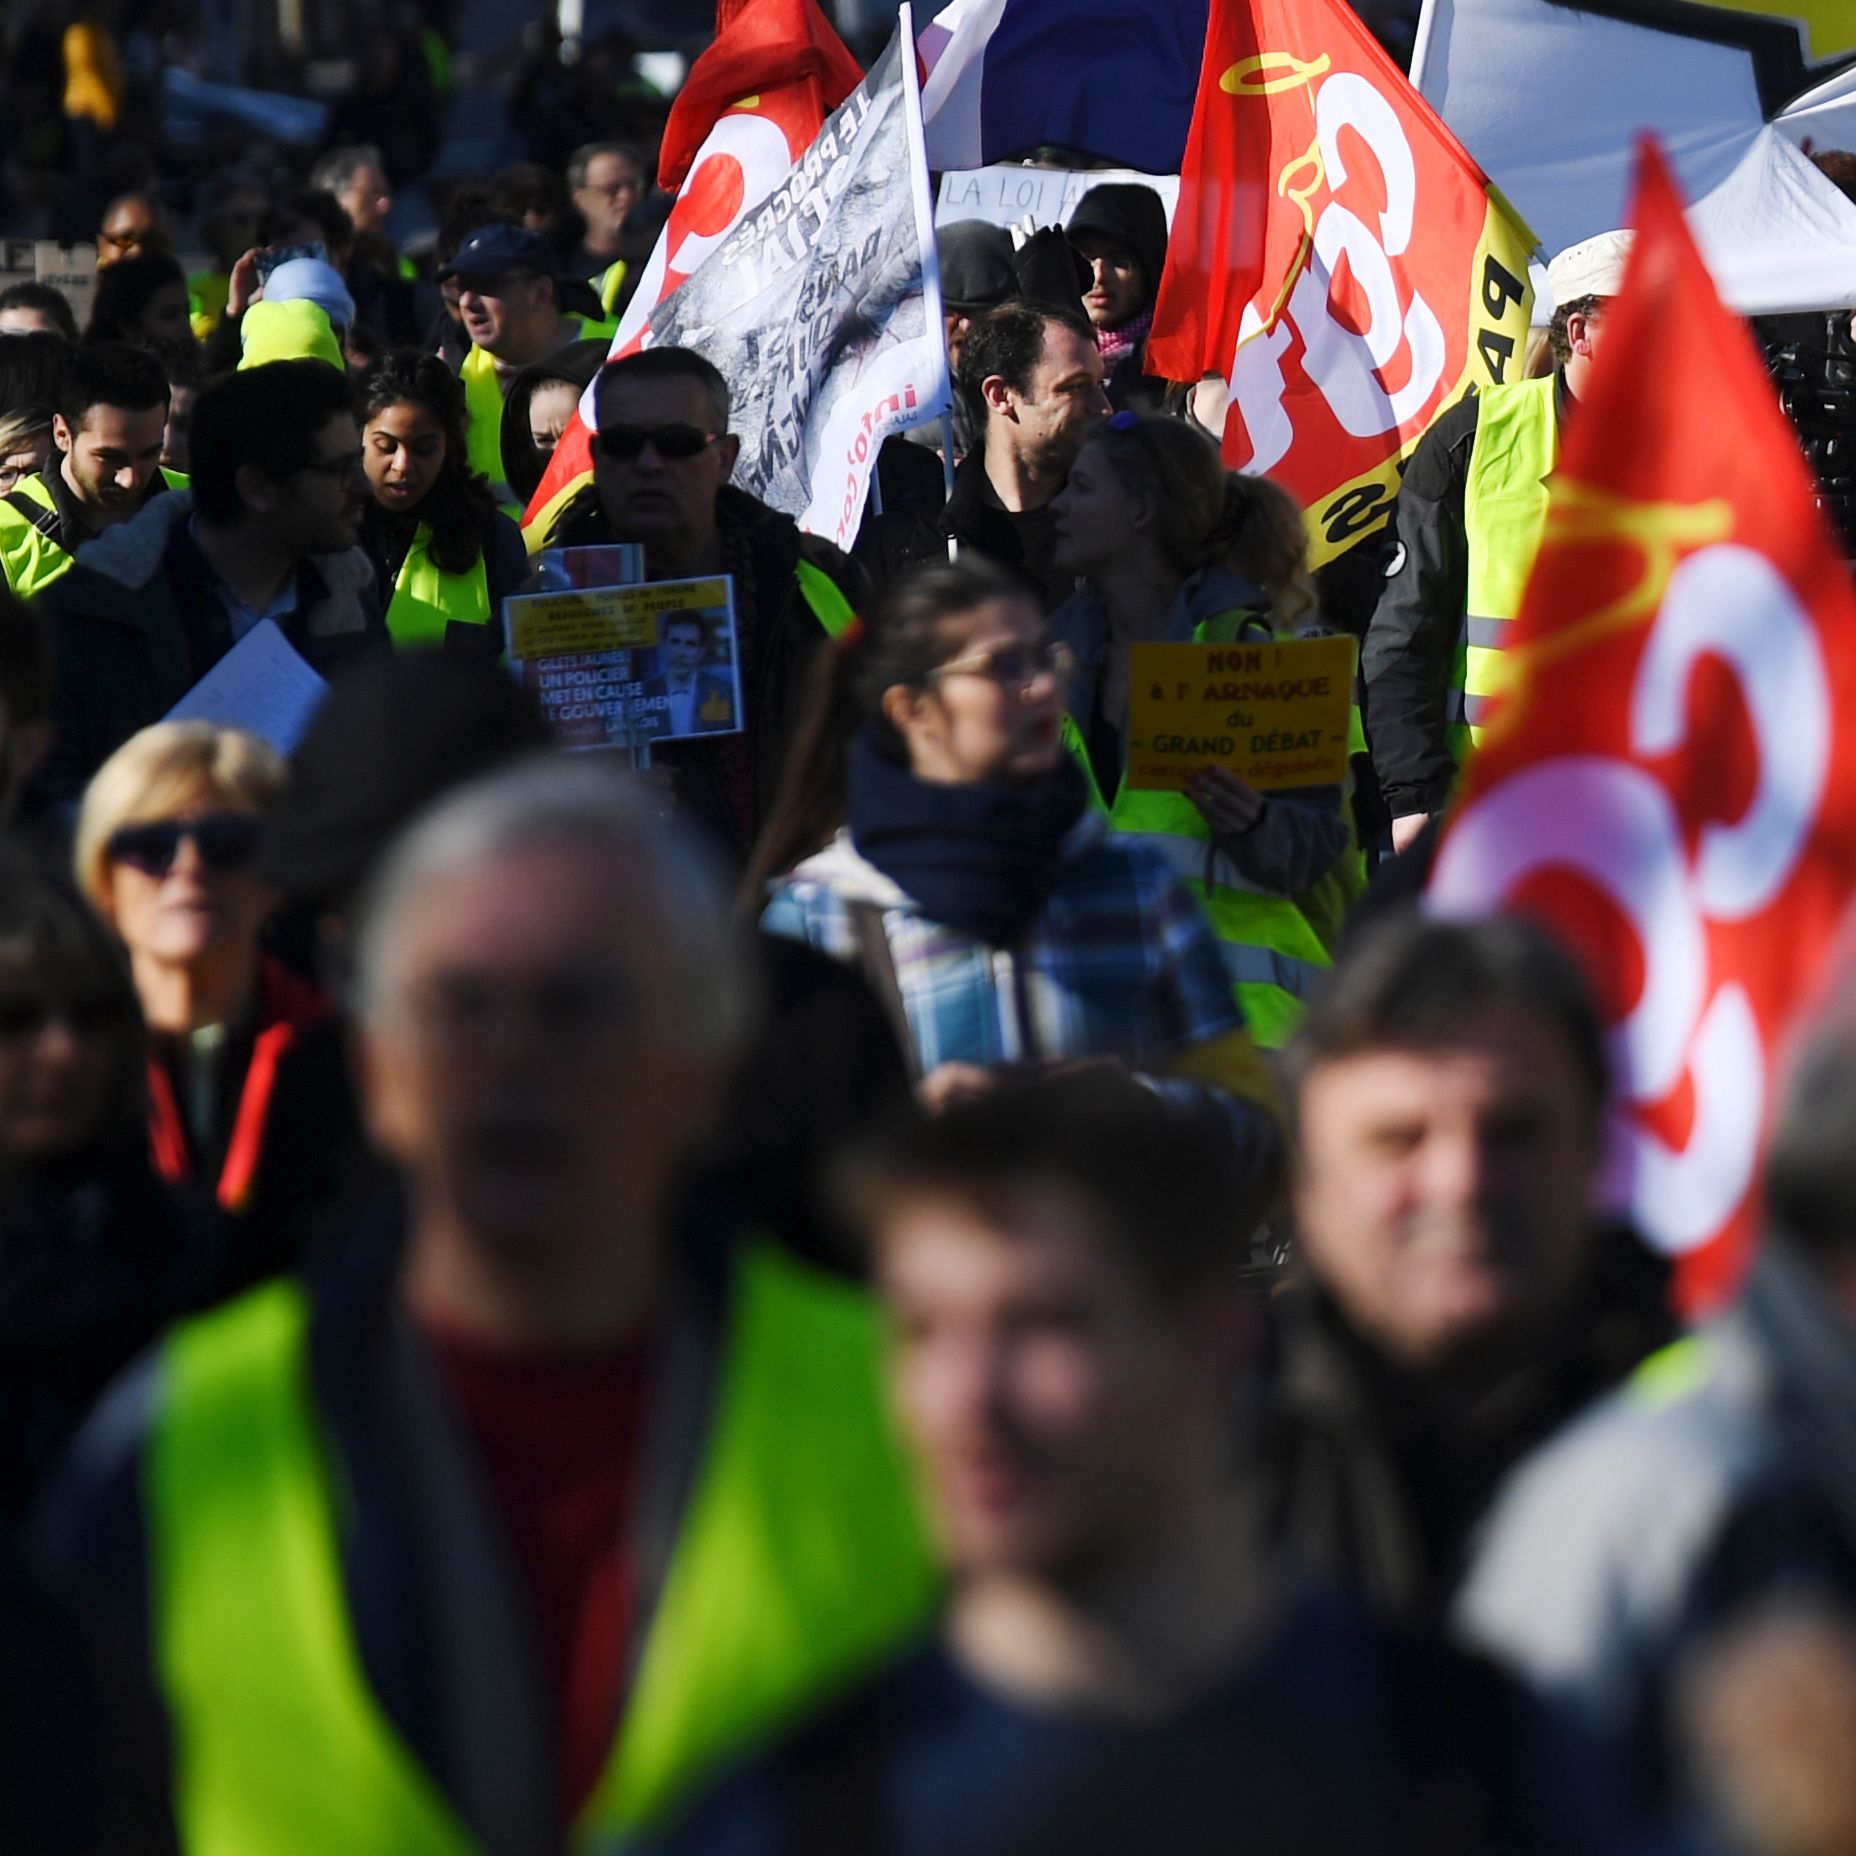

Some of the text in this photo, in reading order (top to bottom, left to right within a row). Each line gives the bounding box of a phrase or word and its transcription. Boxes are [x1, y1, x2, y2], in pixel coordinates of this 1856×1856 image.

[945, 176, 982, 206] LA
[998, 175, 1045, 212] LOI
[1207, 649, 1262, 674] NON
[539, 670, 562, 689] UN
[1152, 734, 1235, 755] GRAND
